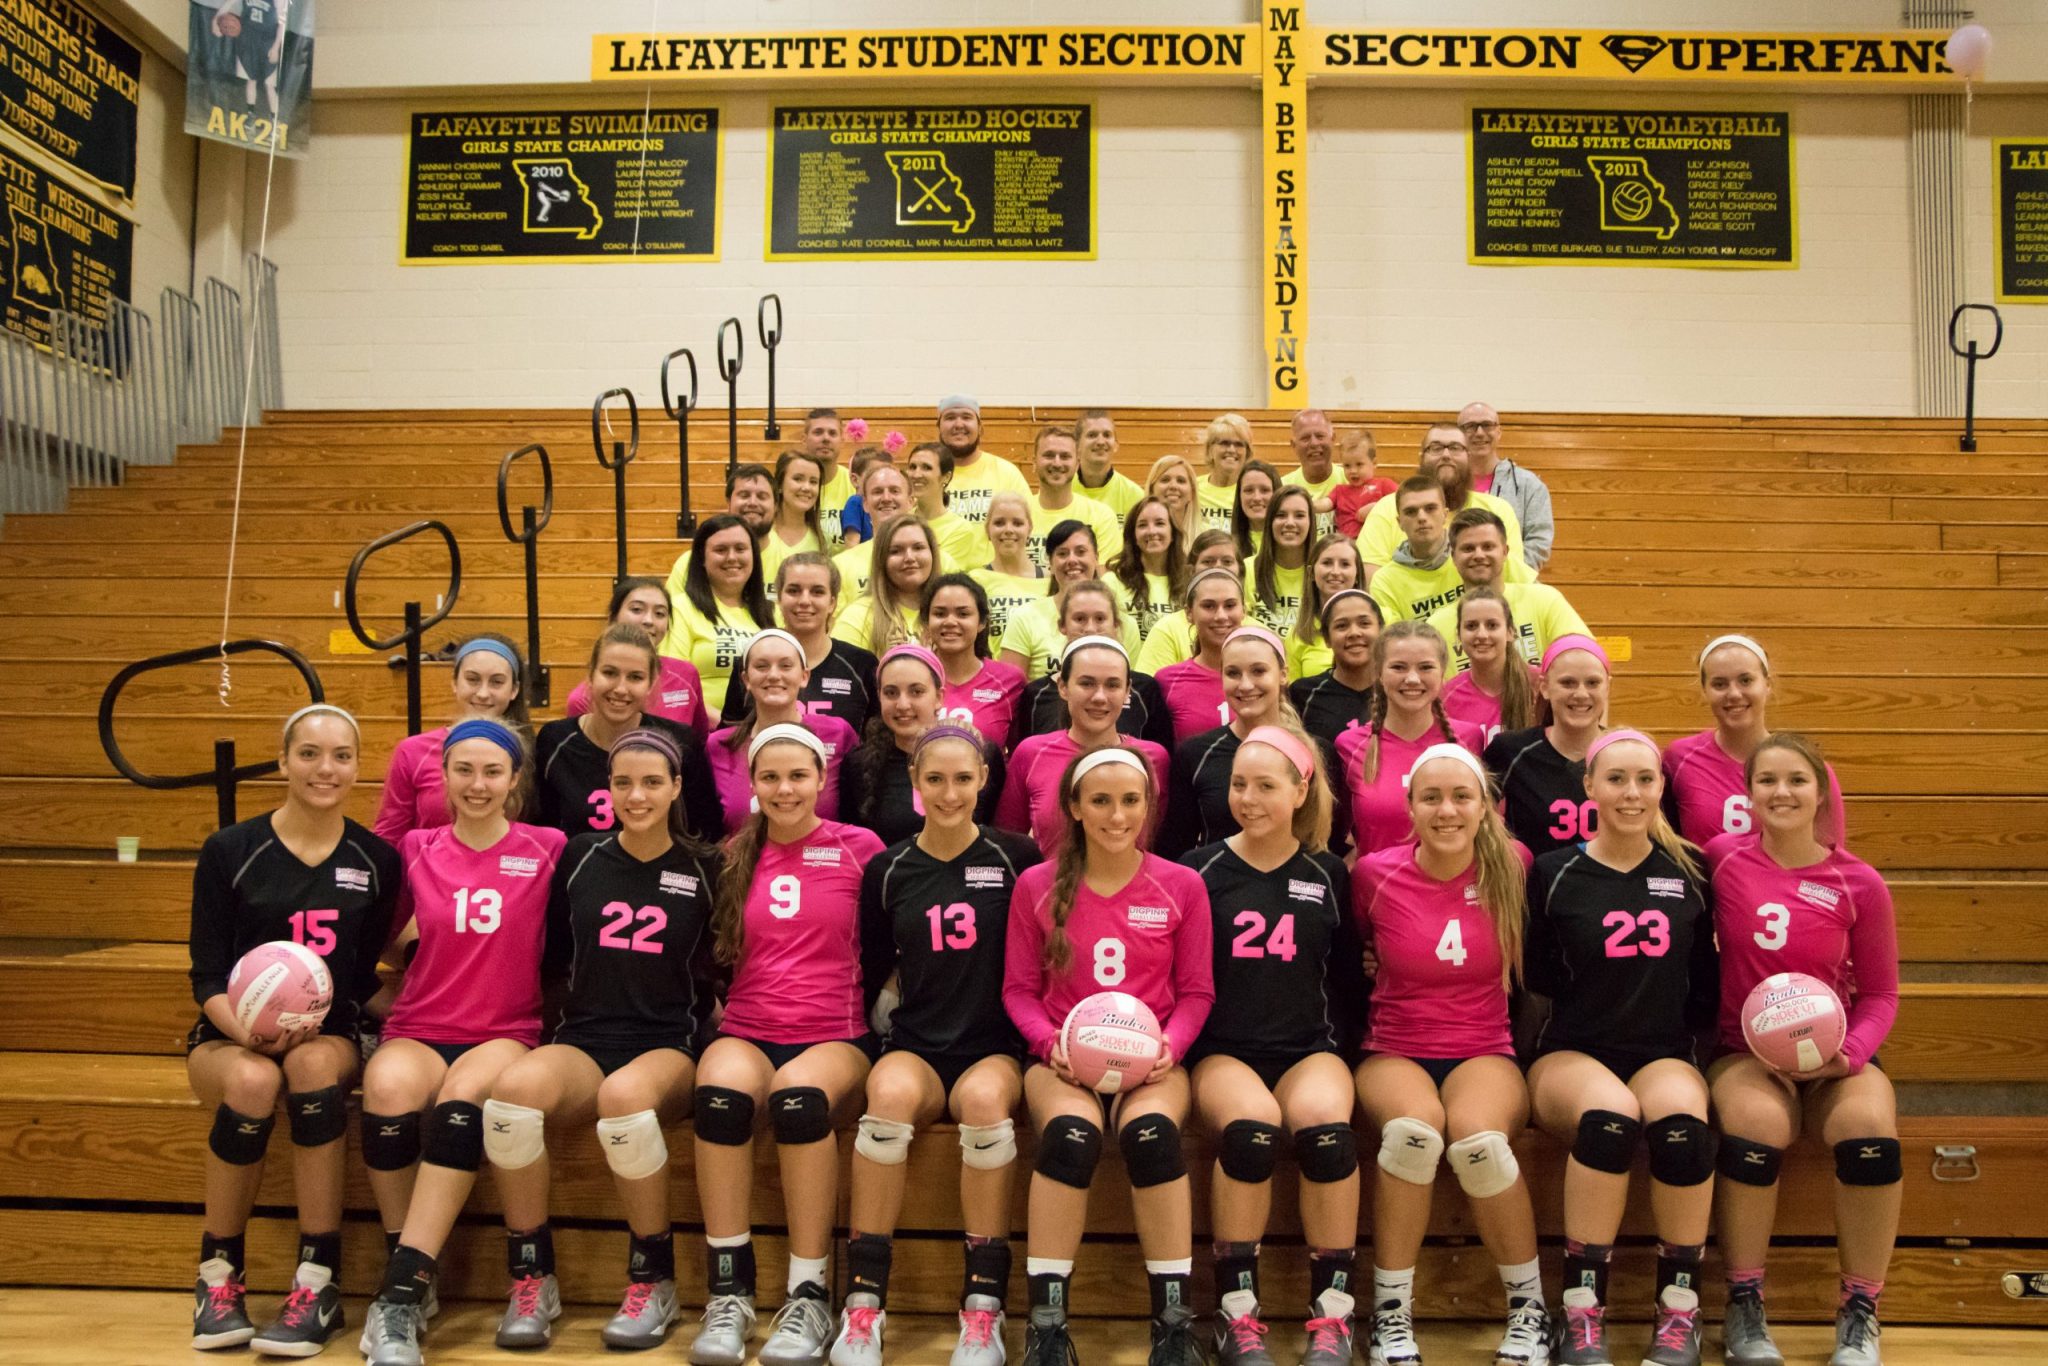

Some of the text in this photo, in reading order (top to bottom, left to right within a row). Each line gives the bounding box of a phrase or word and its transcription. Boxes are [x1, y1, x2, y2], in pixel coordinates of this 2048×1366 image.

[609, 34, 1246, 72] LAFAYETTE STUDENT SECTION
[1325, 33, 1581, 69] SECTION
[58, 58, 99, 102] STATE
[85, 46, 138, 106] TRACK
[11, 53, 92, 121] CHAMPIONS
[25, 88, 56, 121] 1989
[207, 106, 288, 150] AK 21
[420, 114, 708, 136] LAFAYETTE SWIMMING
[782, 109, 1082, 131] LAFAYETTE FIELD HOCKEY
[1481, 113, 1780, 136] LAFAYETTE VOLLEYBALL
[462, 139, 664, 153] GIRLS STATE CHAMPIONS
[830, 131, 1031, 144] GIRLS STATE CHAMPIONS
[1531, 136, 1732, 150] GIRLS STATE CHAMPIONS
[418, 163, 452, 171] HANNAH
[903, 157, 936, 170] 2011
[1487, 157, 1559, 166] ASHLEY BEATON
[1706, 161, 1750, 170] JOHNSON
[2010, 151, 2048, 169] LA
[531, 166, 563, 178] 2010
[1487, 167, 1583, 177] STEPHANIE CAMPBELL
[1605, 163, 1639, 176] 2011
[1723, 171, 1752, 180] JONES
[1487, 178, 1556, 186] MELANIE CROW
[1688, 181, 1719, 189] GRACE
[1269, 8, 1299, 391] MAY BE STANDING
[1487, 188, 1547, 196] MARILYN DICK
[1688, 191, 1725, 200] LINDSEY
[47, 181, 119, 240] WRESTLING
[1488, 198, 1546, 206] ABBY FINDER
[1688, 201, 1777, 211] KAYLA RICHARDSON
[5, 183, 92, 246] STATE CHAMPIONS
[1487, 208, 1523, 216] BRENNA
[1688, 212, 1752, 220] JACKIE SCOTT
[1487, 219, 1560, 228] KENZIE HENNING
[1689, 222, 1756, 231] MAGGIE SCOTT
[842, 239, 862, 248] KATE
[916, 239, 940, 247] MARK
[997, 238, 1033, 247] MELISSA
[1036, 238, 1063, 247] LANTZ
[1532, 243, 1558, 252] STEVE
[1605, 245, 1622, 253] SUE
[1662, 246, 1684, 254] ZACH
[1721, 247, 1736, 255] KIM
[1411, 584, 1467, 615] WHER
[1549, 799, 1599, 841] 30
[1722, 794, 1752, 834] 6
[661, 871, 699, 882] DIGPINK
[966, 867, 1004, 875] DIGPINK
[769, 875, 801, 919] 9
[1800, 880, 1842, 897] DIGPINK
[453, 887, 502, 933] 13
[1128, 906, 1169, 916] DIGPINK
[288, 909, 340, 956] 15
[599, 901, 667, 954] 22
[925, 902, 977, 951] 13
[1602, 909, 1671, 958] 23
[1753, 902, 1791, 951] 3
[1232, 910, 1297, 962] 24
[1434, 919, 1467, 966] 4
[1093, 937, 1126, 986] 8
